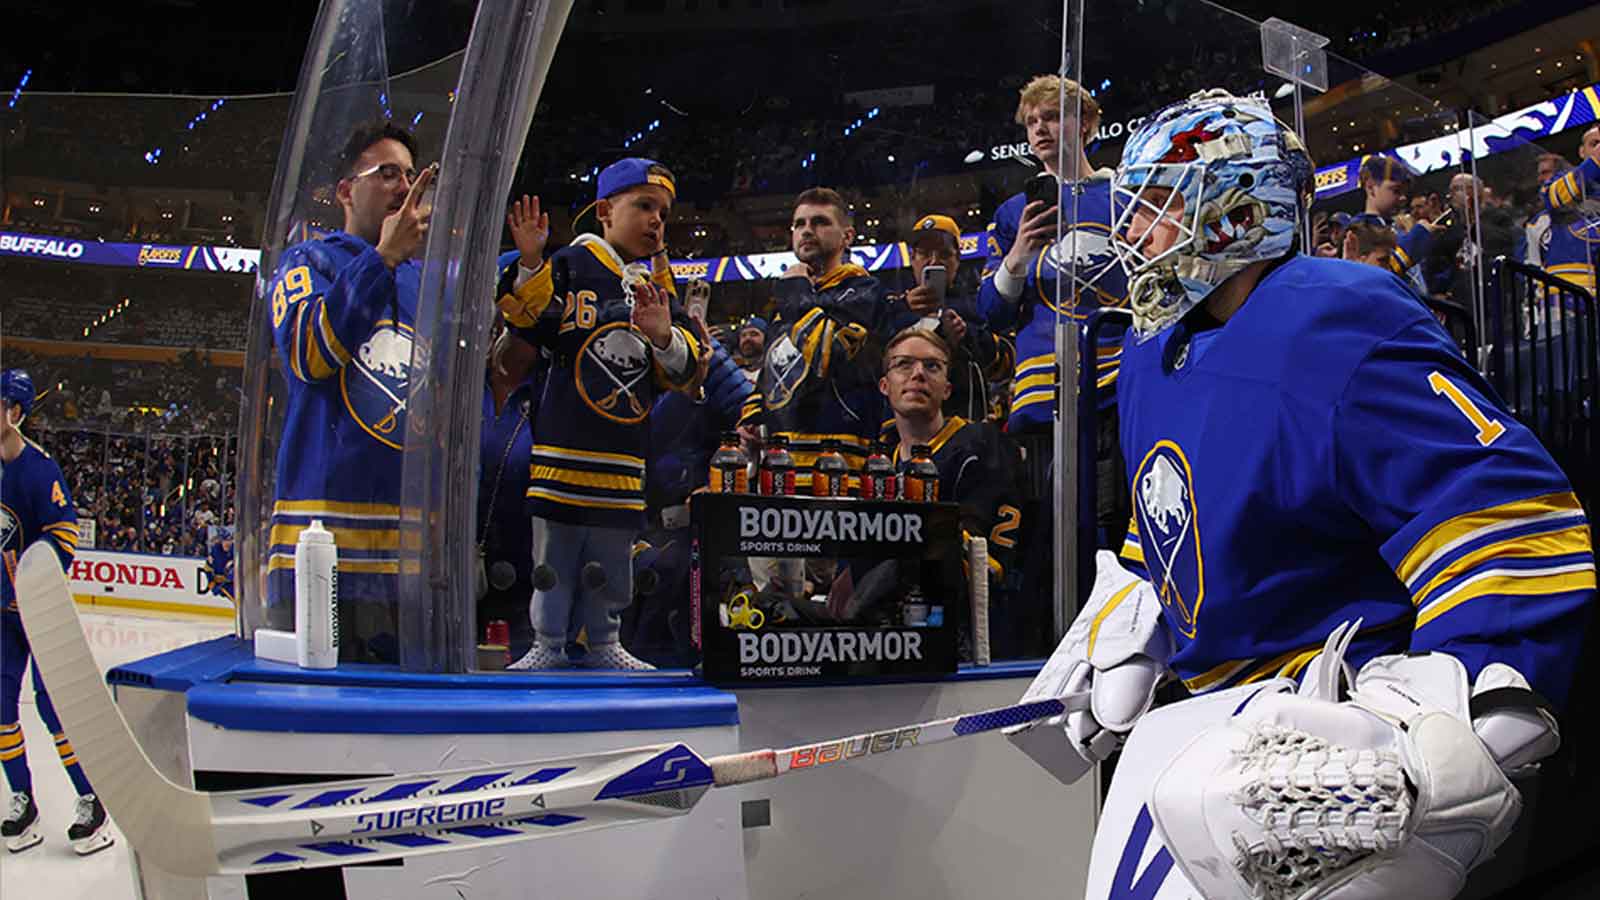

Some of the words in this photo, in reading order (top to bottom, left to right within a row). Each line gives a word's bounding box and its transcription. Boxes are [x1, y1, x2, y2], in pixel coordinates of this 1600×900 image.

[0, 235, 84, 259] BUFFALO
[272, 265, 312, 328] 89
[558, 290, 598, 334] 26
[1427, 370, 1507, 447] 1
[52, 480, 67, 507] 4
[738, 506, 923, 542] BODYARMOR
[990, 504, 1022, 549] 2
[740, 541, 784, 552] SPORTS
[787, 542, 821, 552] DRINK
[71, 560, 184, 589] HONDA
[738, 631, 923, 664] BODYARMOR
[740, 666, 784, 677] SPORTS
[787, 666, 821, 676] DRINK
[790, 727, 922, 769] BAUER
[351, 798, 505, 833] SUPREME
